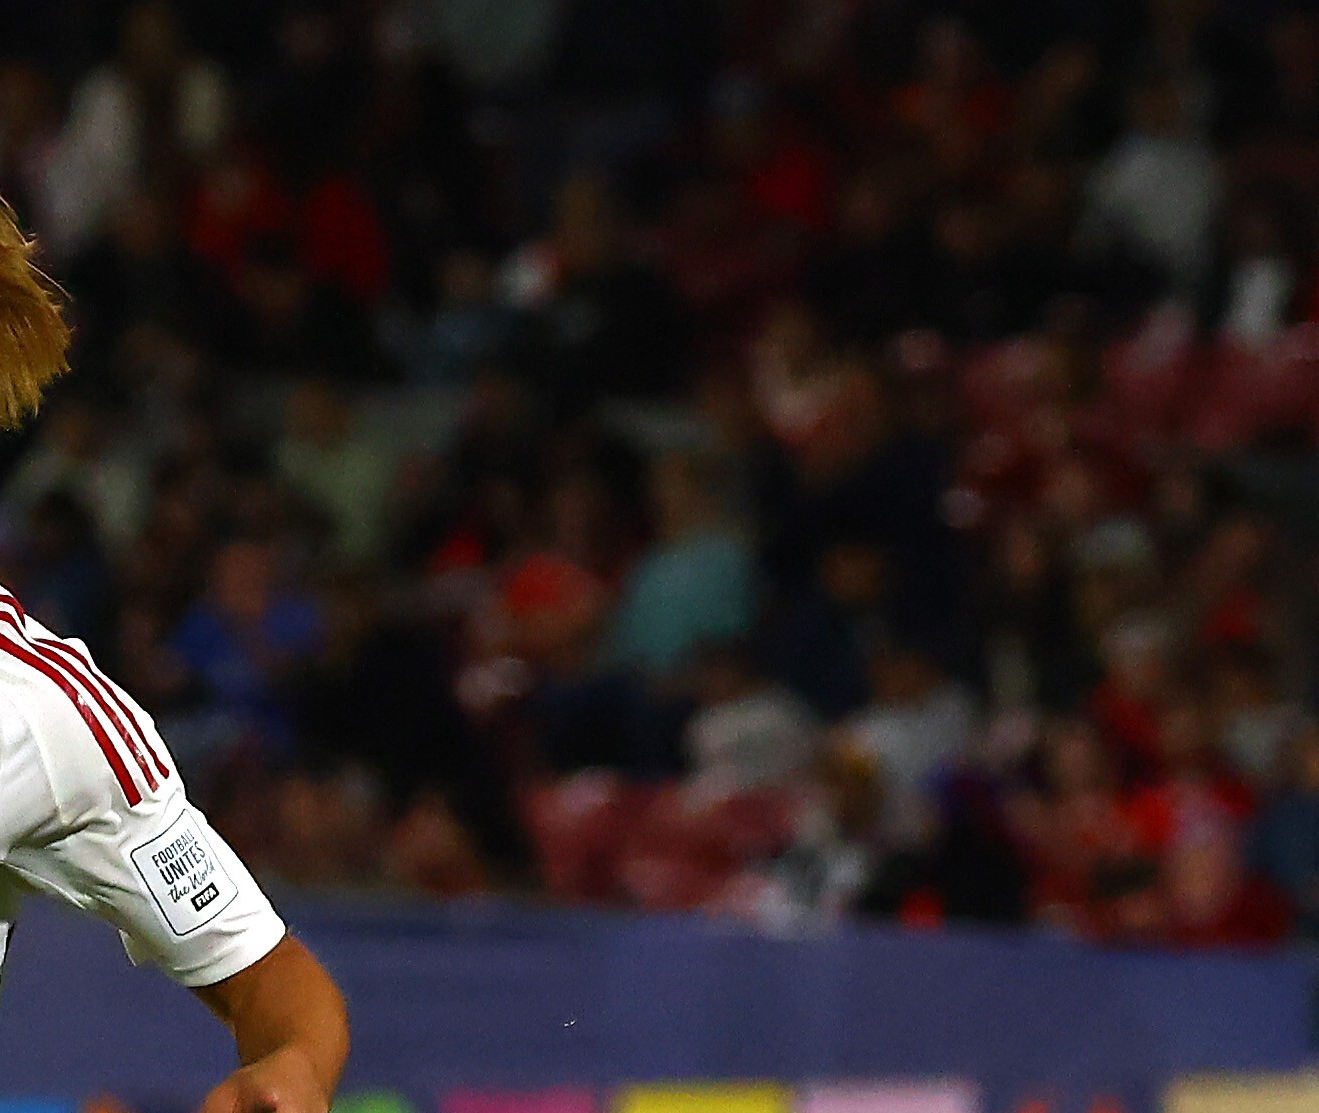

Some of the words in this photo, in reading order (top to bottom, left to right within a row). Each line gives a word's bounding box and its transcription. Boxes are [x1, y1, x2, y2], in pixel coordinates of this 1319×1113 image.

[151, 828, 195, 868] FOOTBALL
[159, 840, 206, 886] UNITES
[167, 884, 190, 903] the
[194, 885, 218, 908] FIFA
